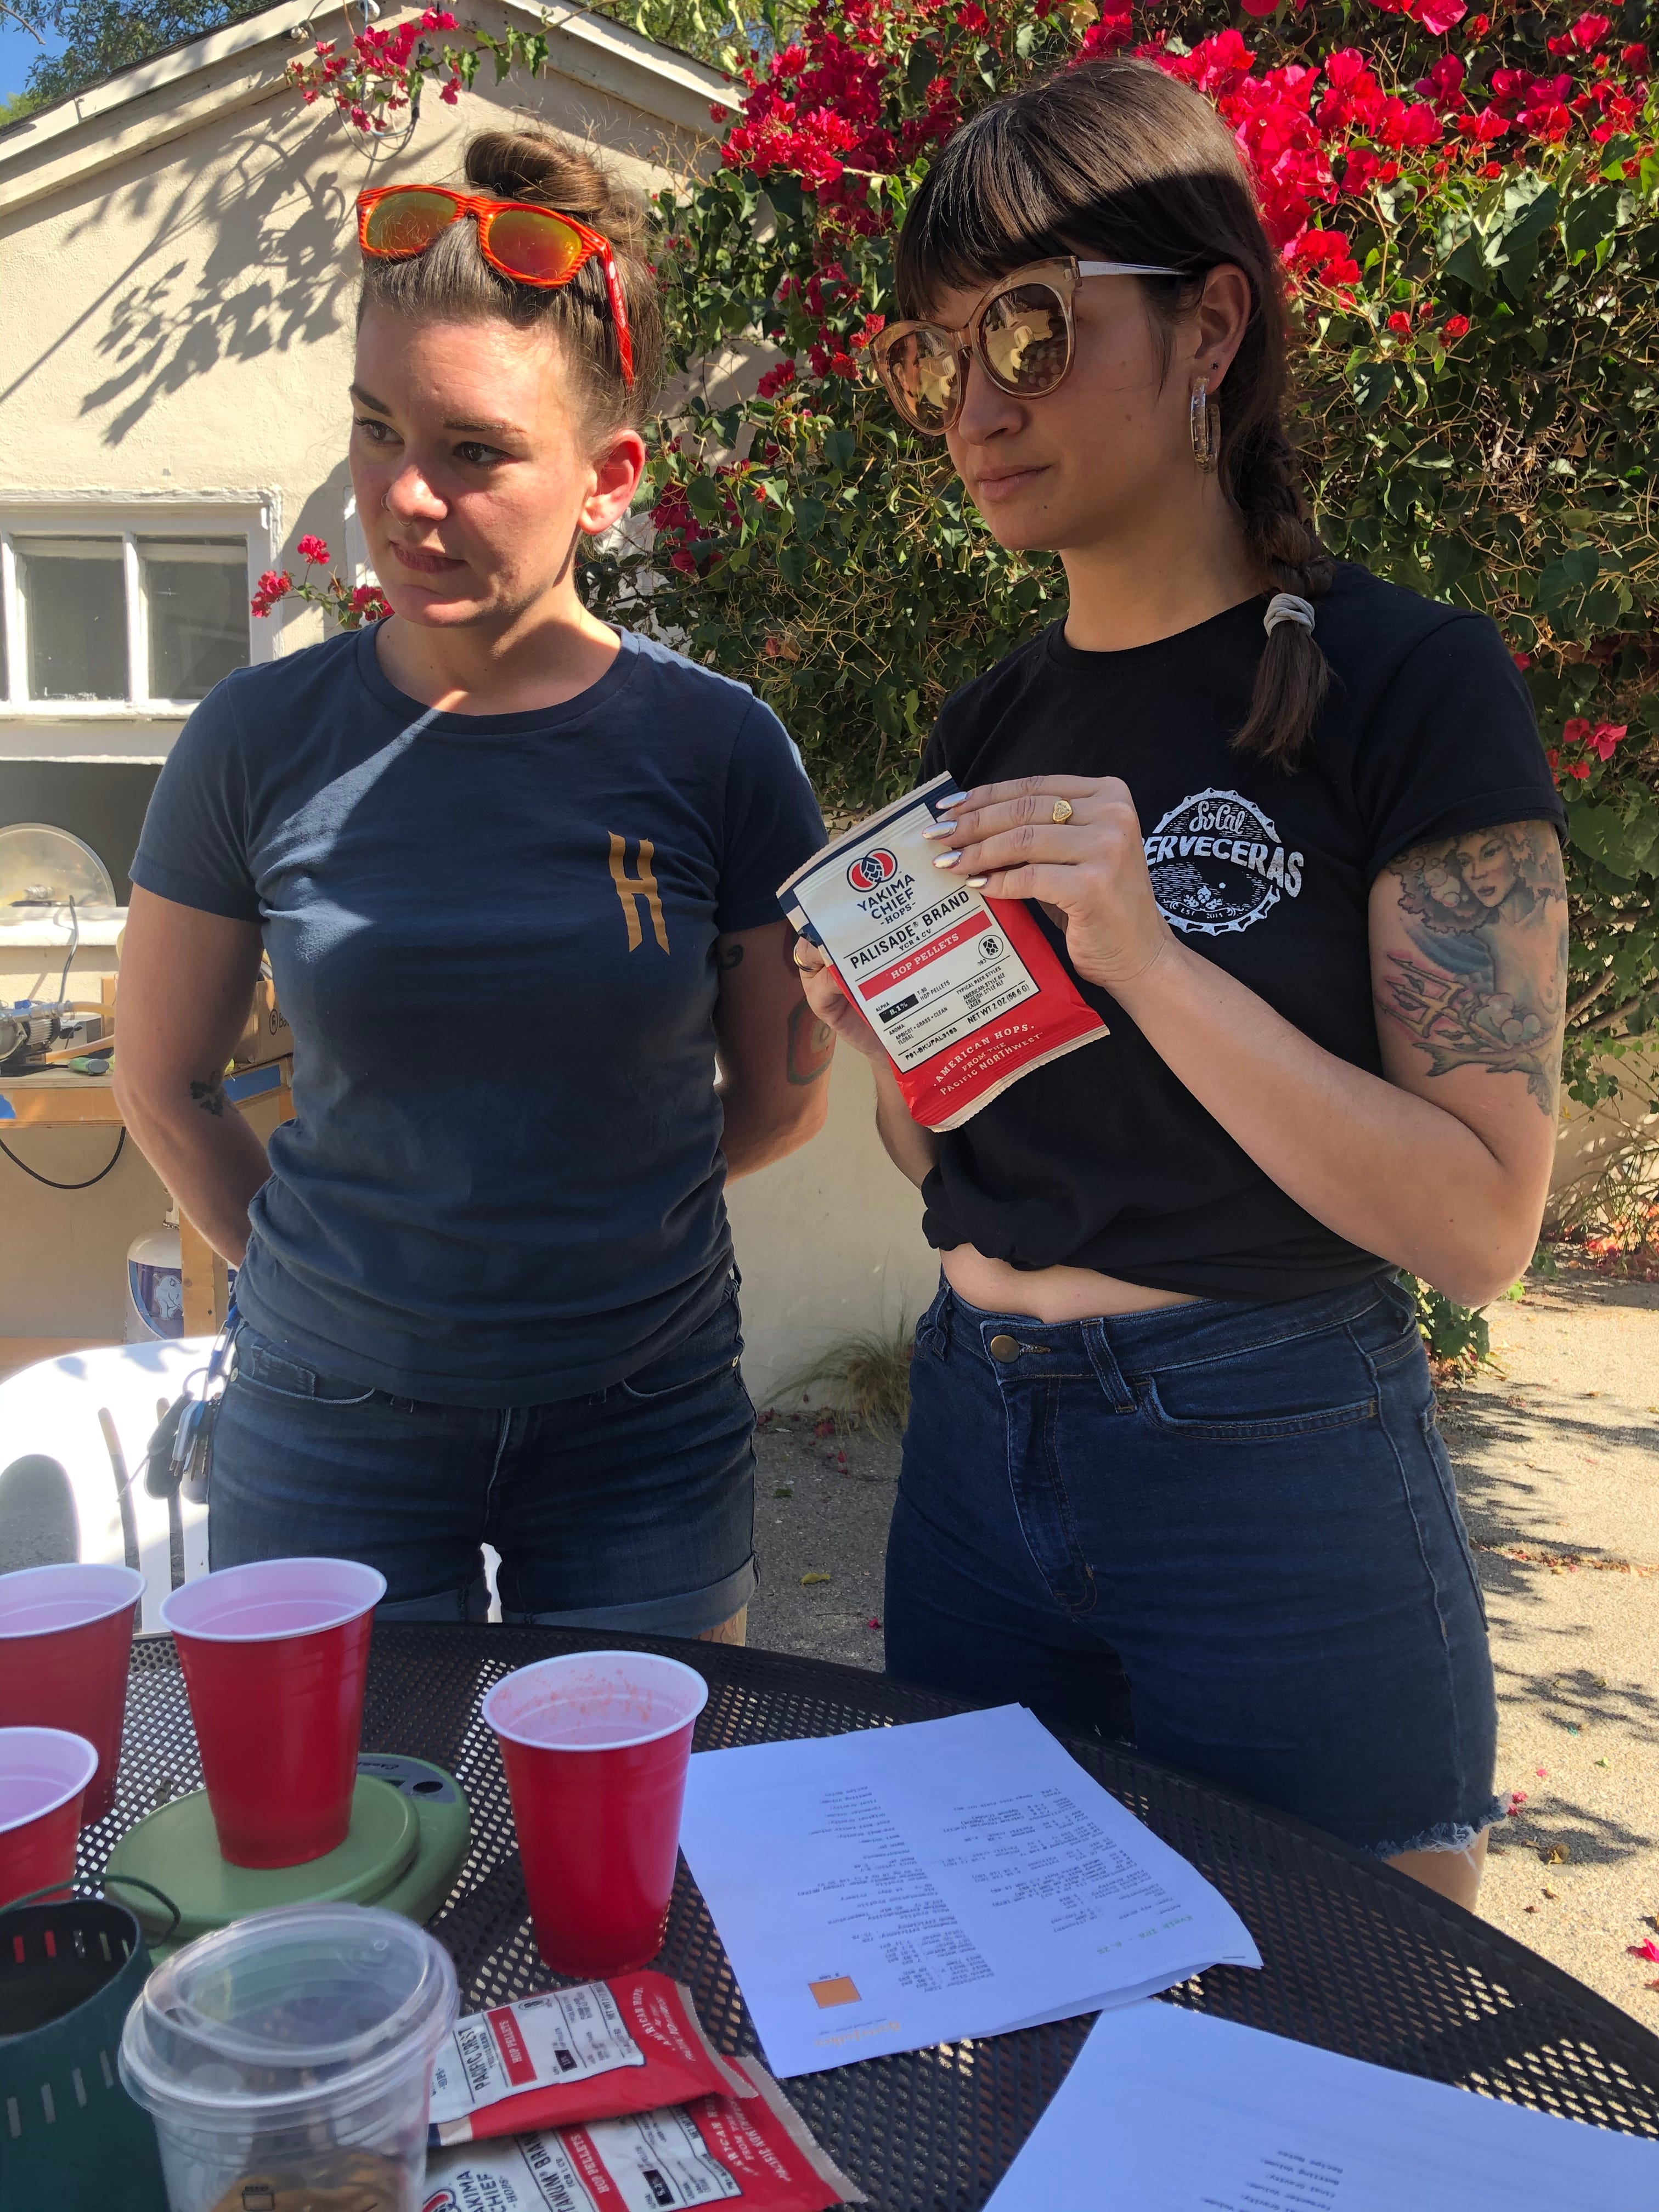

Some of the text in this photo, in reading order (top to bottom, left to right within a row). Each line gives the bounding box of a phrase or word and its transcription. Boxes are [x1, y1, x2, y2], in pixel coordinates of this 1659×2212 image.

[1189, 800, 1246, 834] SoCal
[1142, 836, 1304, 898] ERVECERAS
[607, 831, 670, 956] H
[856, 873, 915, 912] YAKIMA
[870, 887, 915, 920] CHIEF
[922, 890, 970, 926] BRAND
[890, 933, 960, 979] HOP PELLETS
[899, 939, 915, 951] YCR
[921, 928, 932, 938] CV
[889, 980, 950, 1016] 8.1% HOP PELLETS
[956, 983, 974, 994] TYPICAL
[985, 966, 1001, 977] STYLES
[875, 1001, 890, 1012] ALPHA
[967, 1012, 981, 1024] NET
[980, 1006, 992, 1016] WT
[996, 997, 1007, 1007] OZ
[1021, 983, 1030, 992] G)
[968, 999, 981, 1009] LAGER
[895, 1006, 948, 1040] APRICOT GRASS CLEAN
[940, 1034, 1040, 1095] PACIFIC NORTHWEST
[961, 1042, 1006, 1071] FROM THE
[456, 2170, 484, 2212] AKIMA
